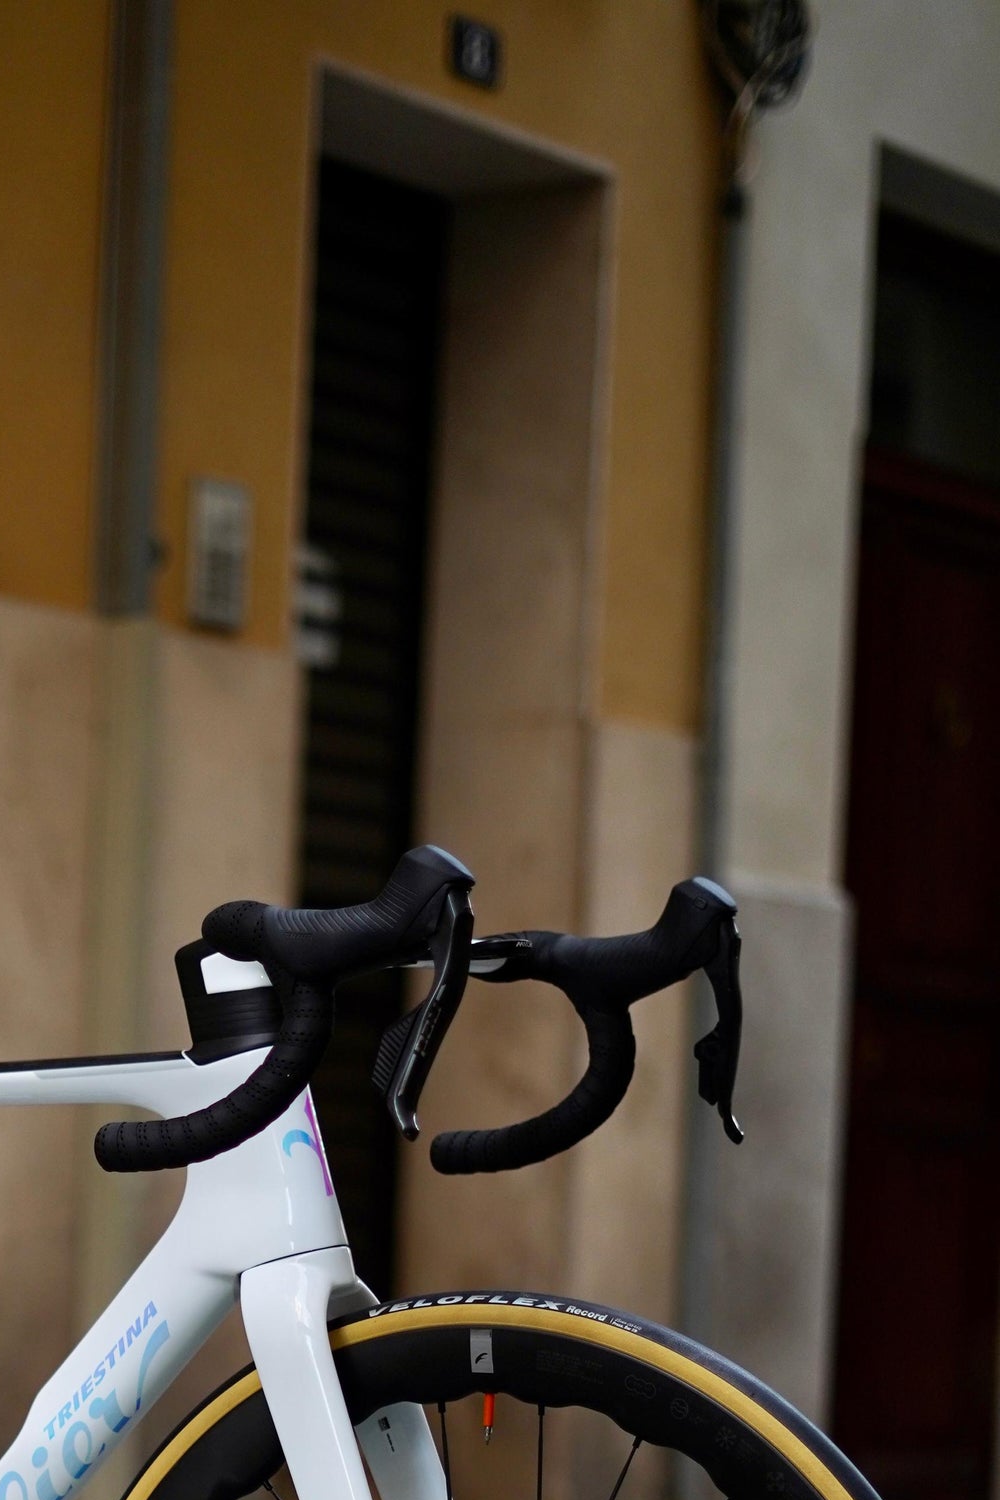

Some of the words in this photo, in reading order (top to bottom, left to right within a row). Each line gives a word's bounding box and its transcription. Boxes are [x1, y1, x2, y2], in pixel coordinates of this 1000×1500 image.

[368, 1293, 567, 1319] VELOFLEX
[565, 1304, 608, 1323] Record
[43, 1300, 158, 1441] TRIESTINA
